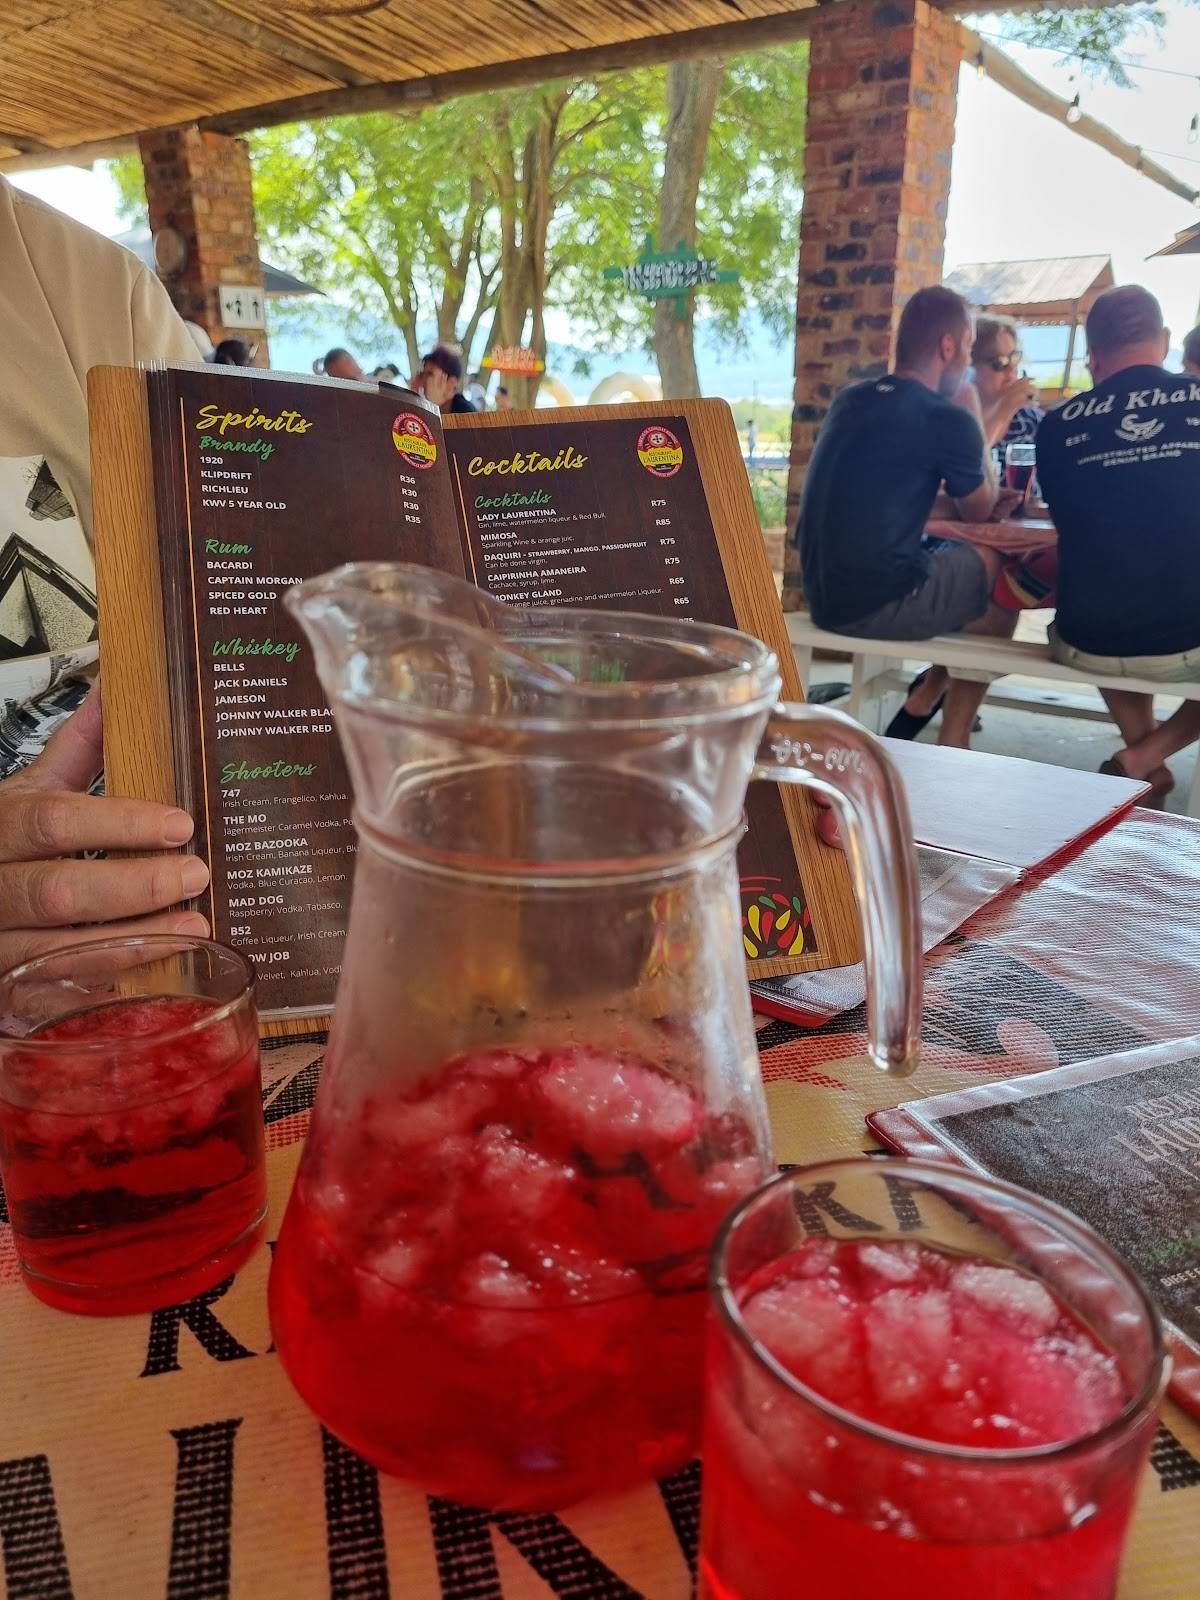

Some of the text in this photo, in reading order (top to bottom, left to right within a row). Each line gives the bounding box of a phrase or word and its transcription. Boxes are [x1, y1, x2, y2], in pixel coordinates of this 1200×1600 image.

[1062, 394, 1116, 421] Old
[196, 405, 312, 435] Spirits
[199, 435, 275, 460] Brandy
[200, 456, 223, 464] 1920
[468, 446, 589, 477] Cocktails
[200, 471, 252, 480] KLIPDRIFT
[400, 474, 416, 485] R36
[202, 485, 248, 494] RICHLIEU
[401, 488, 418, 498] R30
[202, 499, 286, 510] KWV 5 YEAR OLD
[474, 489, 552, 508] Cocktails
[403, 501, 420, 511] R30
[405, 514, 421, 524] R35
[477, 508, 556, 522] LADY LAURENTINA
[509, 517, 548, 526] watermelon
[579, 512, 592, 520] Red
[655, 518, 671, 526] R85
[480, 532, 518, 541] MIMOSA
[205, 538, 253, 555] Rum
[482, 541, 512, 550] Sparkling
[538, 536, 560, 544] orange
[484, 552, 522, 562] DAQUIRI
[528, 548, 573, 558] STRAWBERRY,
[602, 542, 647, 551] PASSIONFRUIT
[206, 561, 253, 570] BACARDI
[487, 566, 587, 582] CAIPIRINHA AMANEIRA
[208, 576, 303, 586] CAPTAIN MORGAN
[669, 577, 685, 585] R65
[208, 591, 277, 600] SPICED GOLD
[531, 589, 562, 598] GLAND
[550, 596, 583, 606] grenadine
[584, 594, 598, 602] and
[598, 590, 637, 600] watermelon
[674, 597, 690, 605] R65
[210, 606, 268, 616] RED HEART
[212, 637, 302, 663] Whiskey
[214, 663, 245, 672] BELLS
[214, 678, 288, 690] JACK DANIELS
[215, 694, 266, 706] JAMESON
[216, 711, 262, 723] JOHNNY
[264, 709, 308, 719] WALKER
[217, 724, 332, 740] JOHNNY WALKER RED
[220, 760, 318, 784] Shooters
[221, 789, 241, 798] 747
[222, 800, 241, 808] Irish
[242, 798, 272, 807] Cream,
[223, 814, 267, 826] THE MO
[278, 822, 312, 832] Caramel
[226, 838, 308, 853] MOZ BAZOOKA
[225, 854, 244, 862] Irish
[246, 852, 276, 861] Cream,
[278, 850, 310, 859] Banana
[312, 846, 344, 858] Liqueur,
[227, 864, 313, 880] MOZ KAMIKAZE
[258, 879, 277, 888] Blue
[228, 894, 284, 908] MAD DOG
[229, 908, 275, 919] Raspberry,
[230, 926, 252, 936] B52
[230, 937, 259, 946] Coffee
[261, 934, 296, 945] Liqueur,
[298, 932, 316, 941] Irish
[269, 951, 290, 964] JOB
